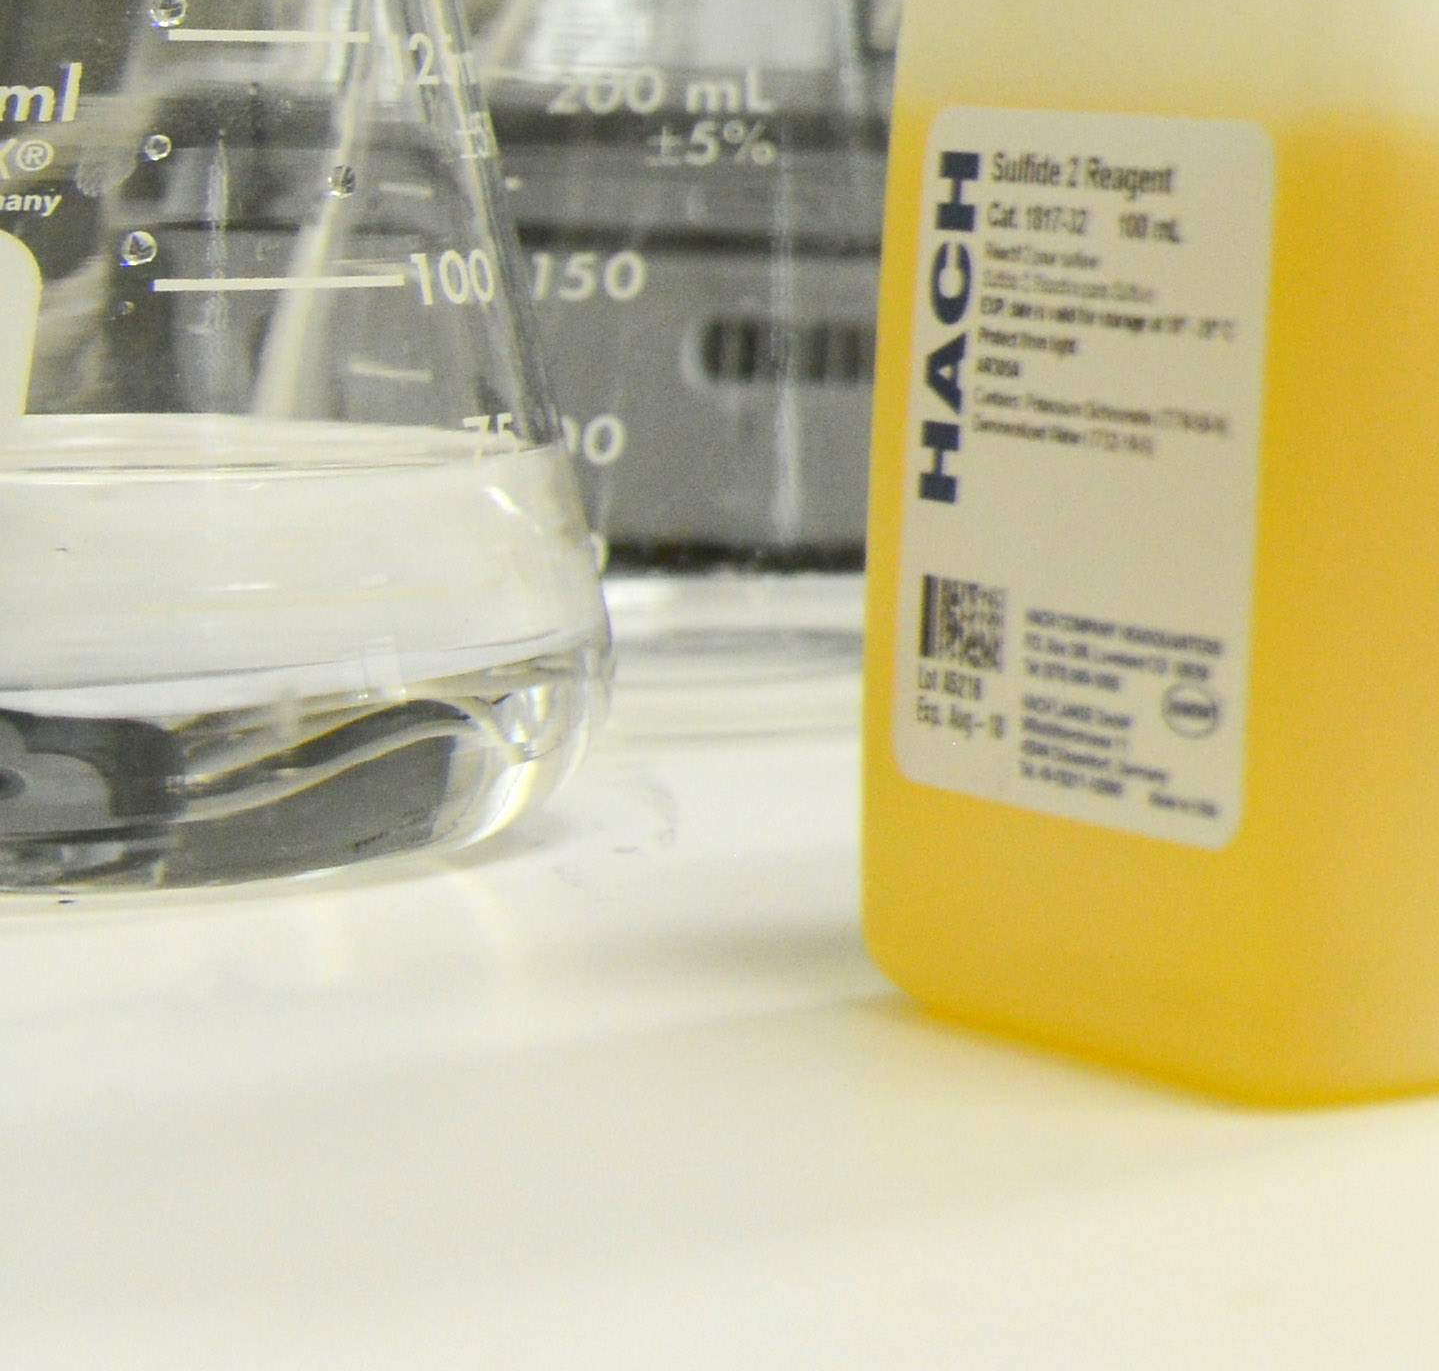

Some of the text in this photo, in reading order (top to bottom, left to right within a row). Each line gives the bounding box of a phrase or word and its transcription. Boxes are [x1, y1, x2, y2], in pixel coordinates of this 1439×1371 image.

[547, 65, 775, 116] 200 mL
[990, 151, 1061, 187] Sulfide
[1085, 156, 1174, 202] Reagent
[410, 248, 495, 306] 100
[531, 249, 648, 302] 150
[918, 150, 981, 505] HACH
